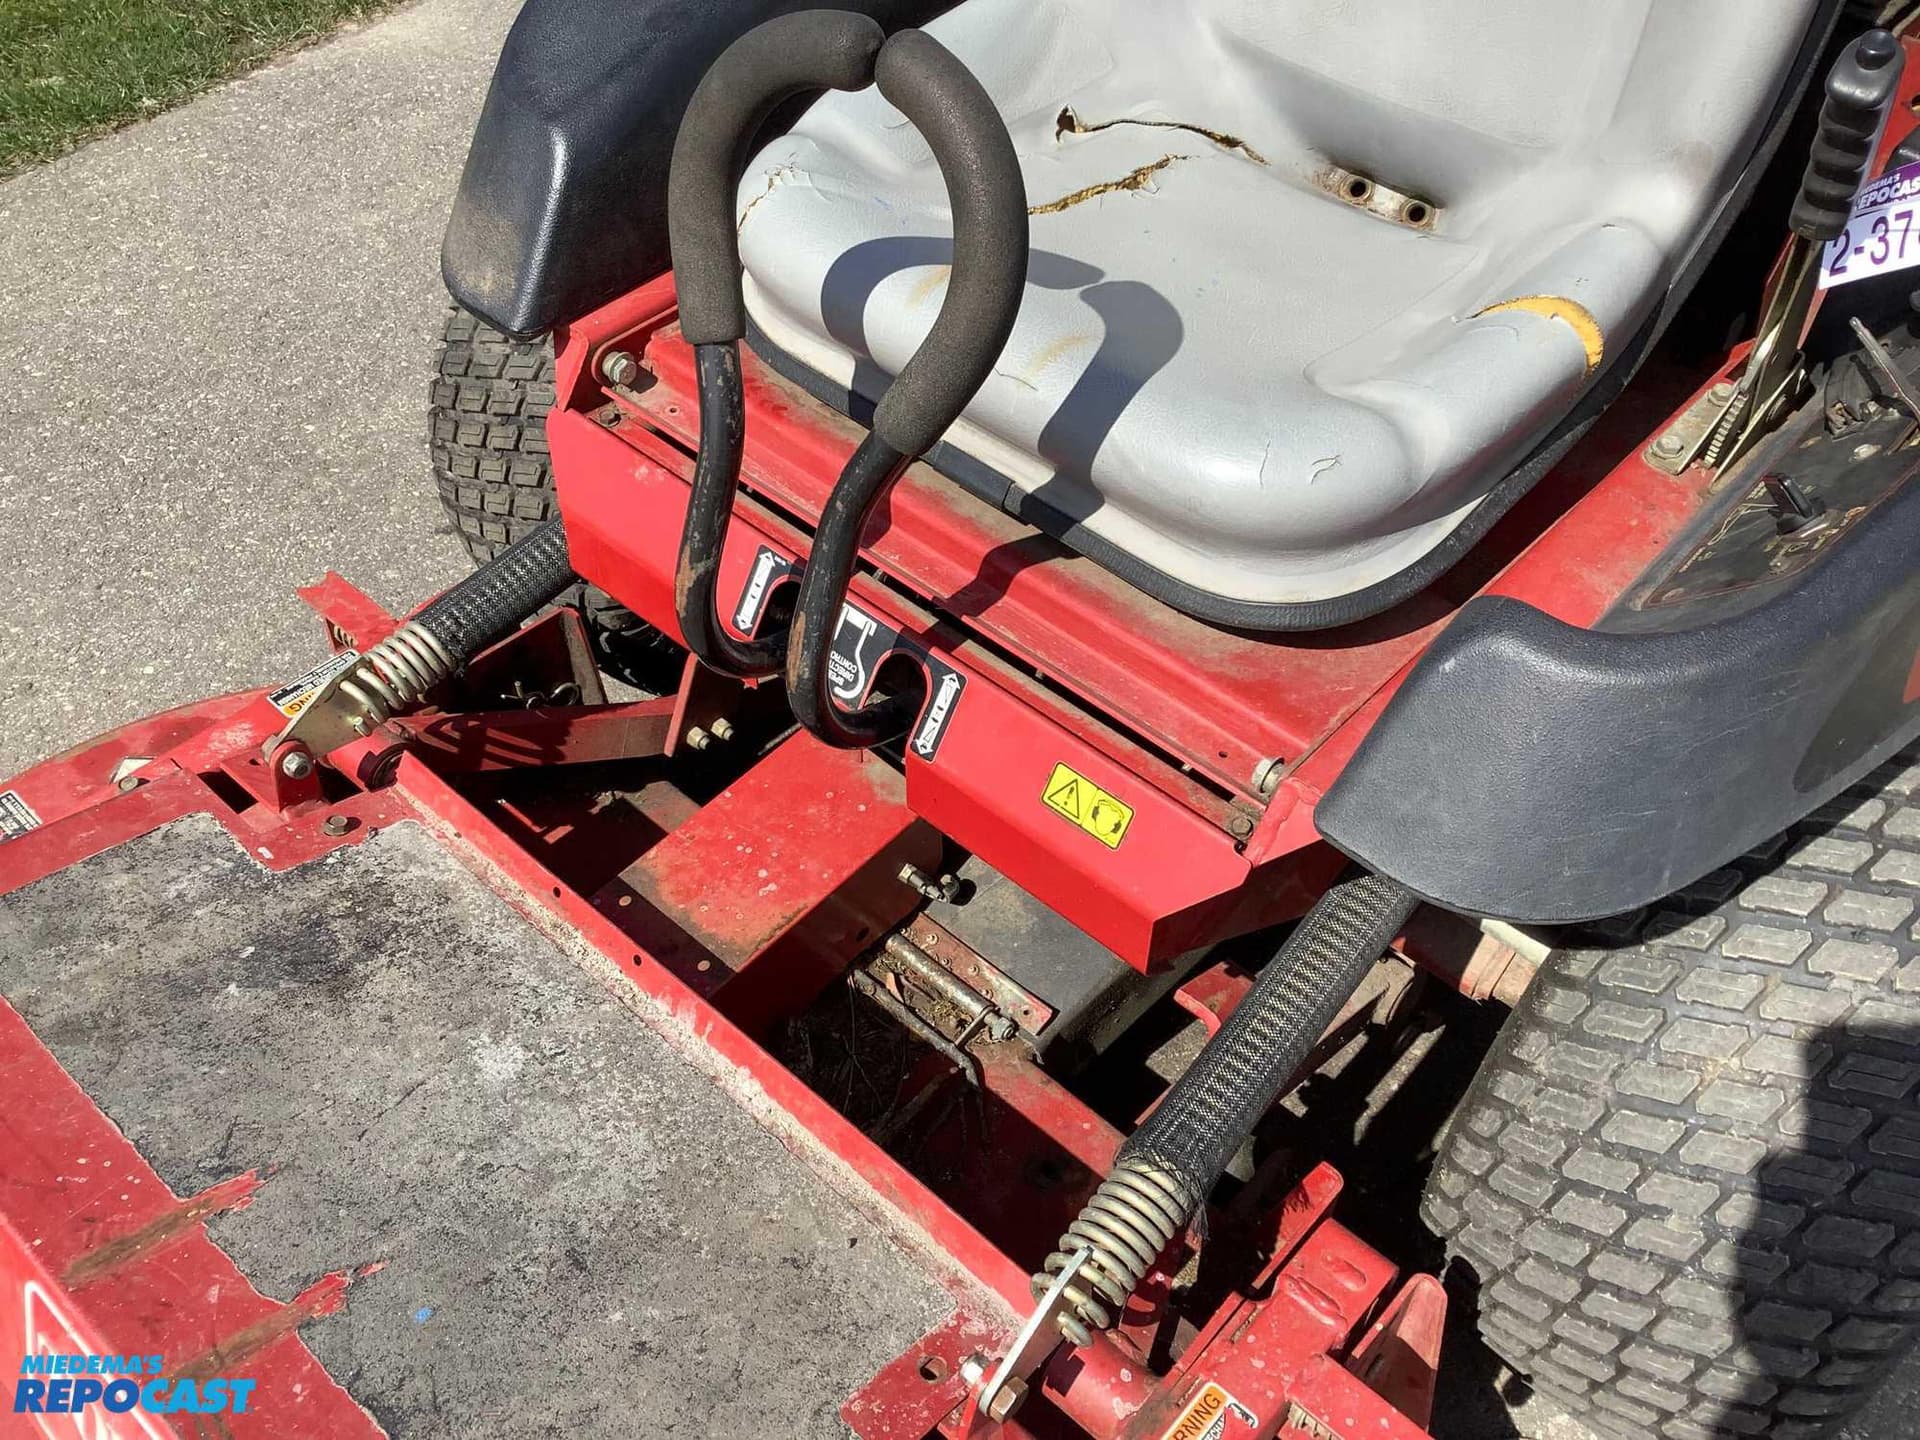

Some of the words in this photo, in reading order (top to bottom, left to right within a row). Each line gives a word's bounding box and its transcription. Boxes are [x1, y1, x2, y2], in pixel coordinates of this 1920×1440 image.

[1829, 210, 1920, 277] 2-37
[830, 650, 857, 673] CONTRO
[1174, 1393, 1221, 1440] RNING
